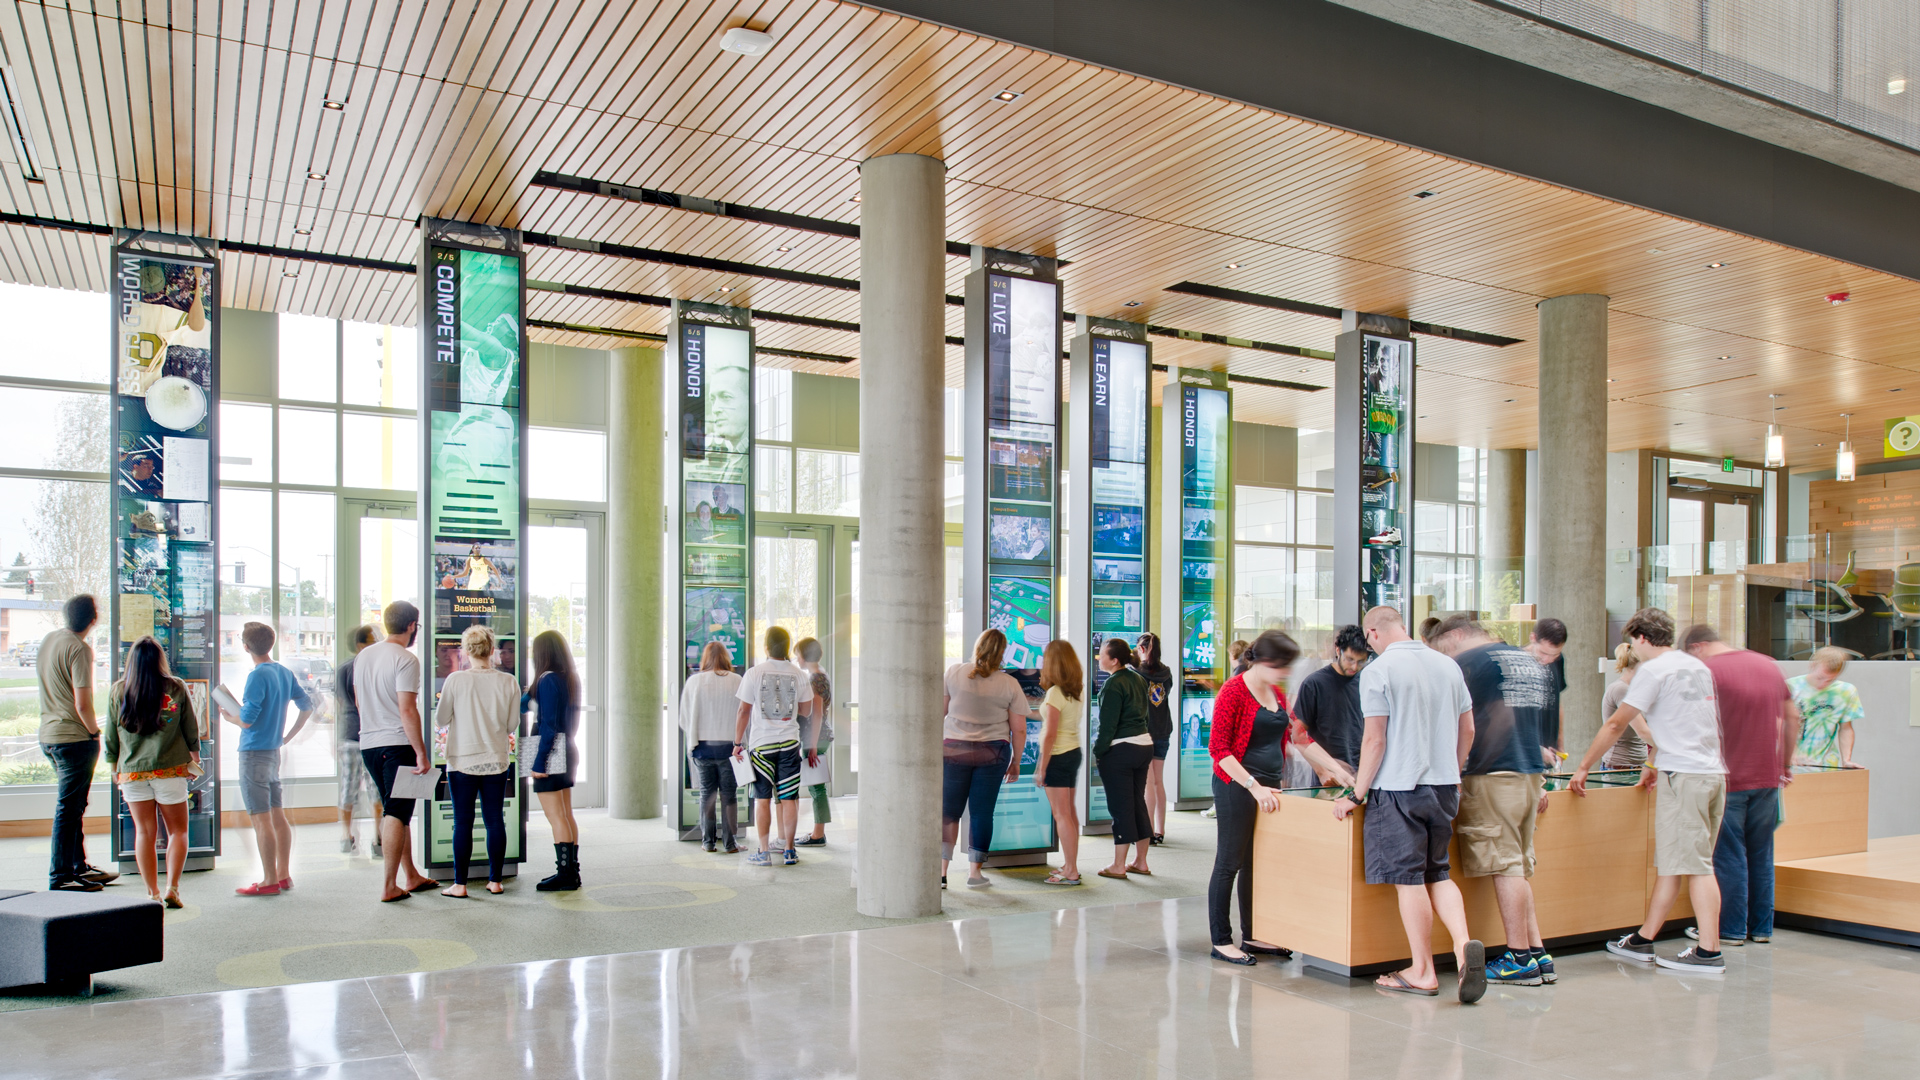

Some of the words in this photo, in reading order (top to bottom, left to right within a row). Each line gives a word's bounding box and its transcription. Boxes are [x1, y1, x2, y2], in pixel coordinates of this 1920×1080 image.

[437, 252, 455, 261] 2/5
[122, 258, 141, 327] WORLD
[437, 265, 454, 364] COMPETE
[992, 292, 1007, 335] LIVE
[123, 331, 141, 394] CLASS
[687, 339, 701, 398] HONOR
[1095, 353, 1107, 406] LEARN
[1185, 399, 1195, 447] HONOR
[453, 604, 497, 613] Basketball
[456, 595, 495, 604] Women's
